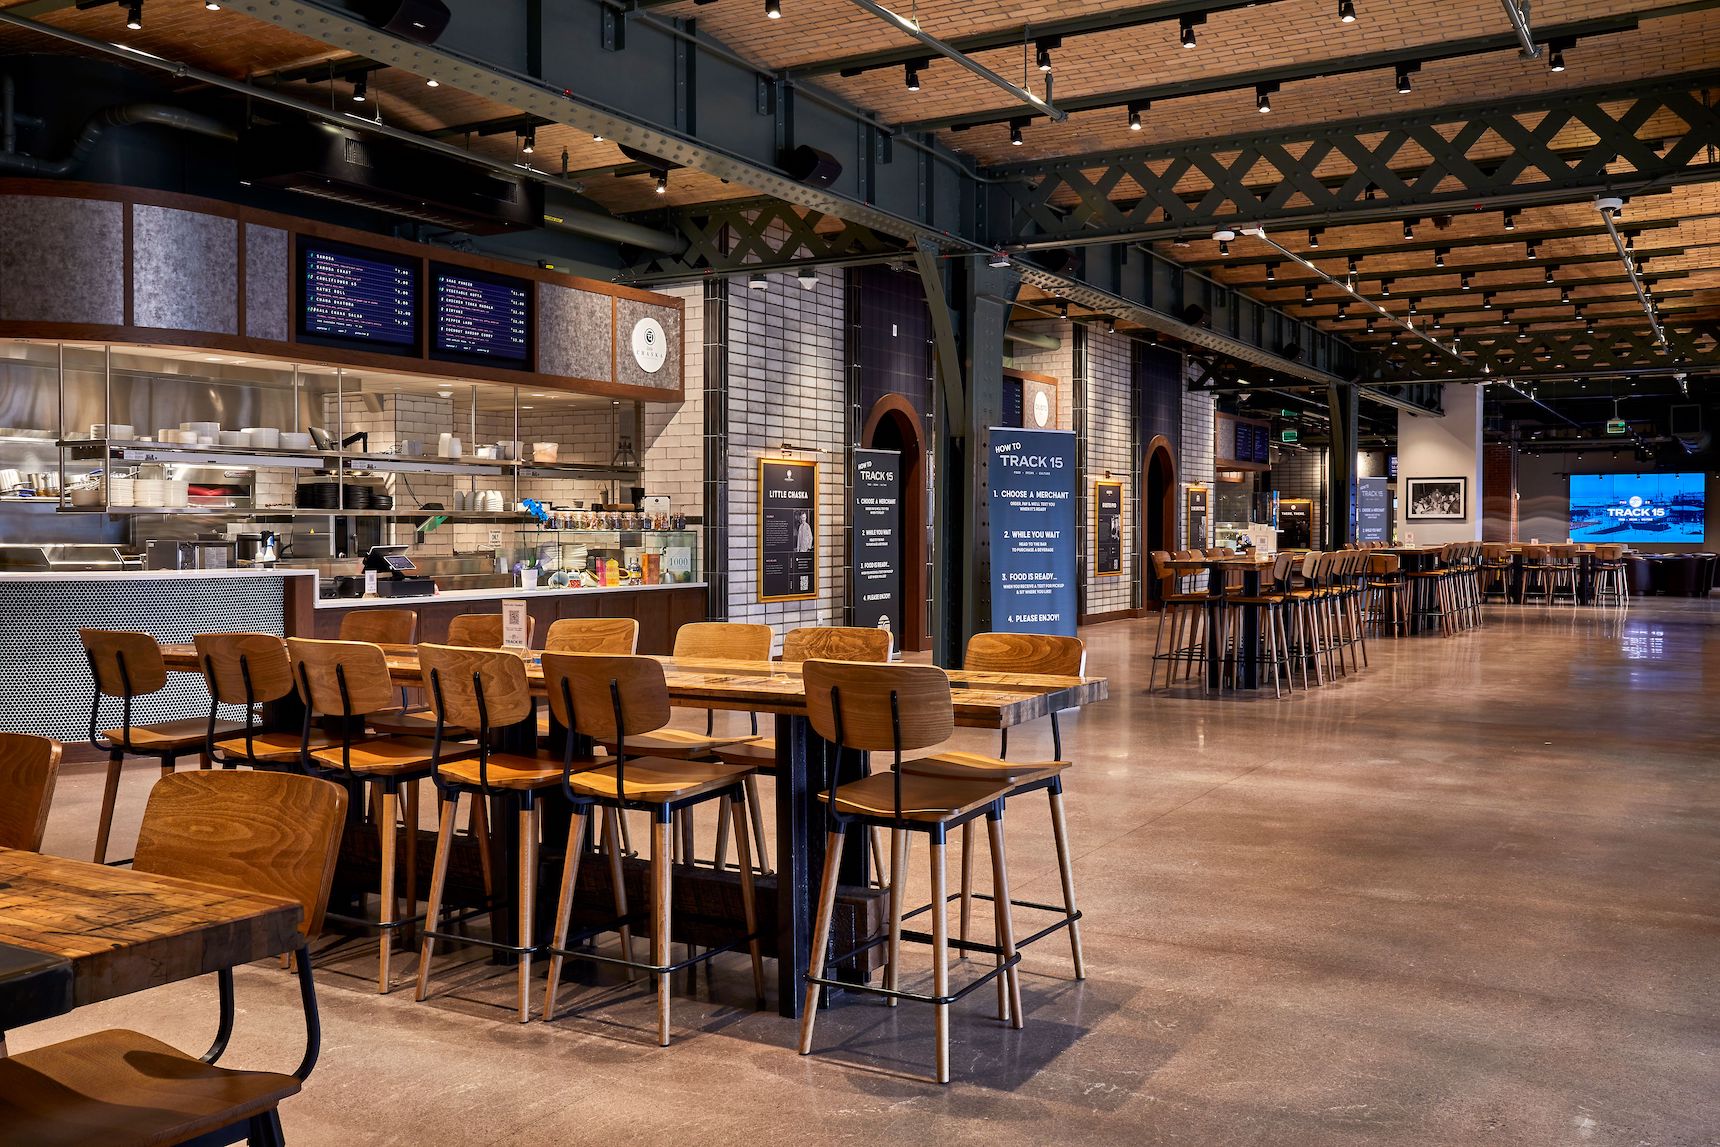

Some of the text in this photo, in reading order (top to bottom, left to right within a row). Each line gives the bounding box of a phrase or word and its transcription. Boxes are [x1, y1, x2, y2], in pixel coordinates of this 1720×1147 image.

[316, 275, 348, 285] CAULIFLOWER
[995, 442, 1021, 453] HOW TO
[858, 462, 866, 470] HOW
[1000, 455, 1063, 468] TRACK 15
[860, 471, 893, 481] TRACK 15
[769, 490, 787, 498] LITTLE
[1001, 490, 1027, 498] CHOOSE
[1607, 508, 1665, 516] TRACK 15
[670, 557, 688, 566] 1000
